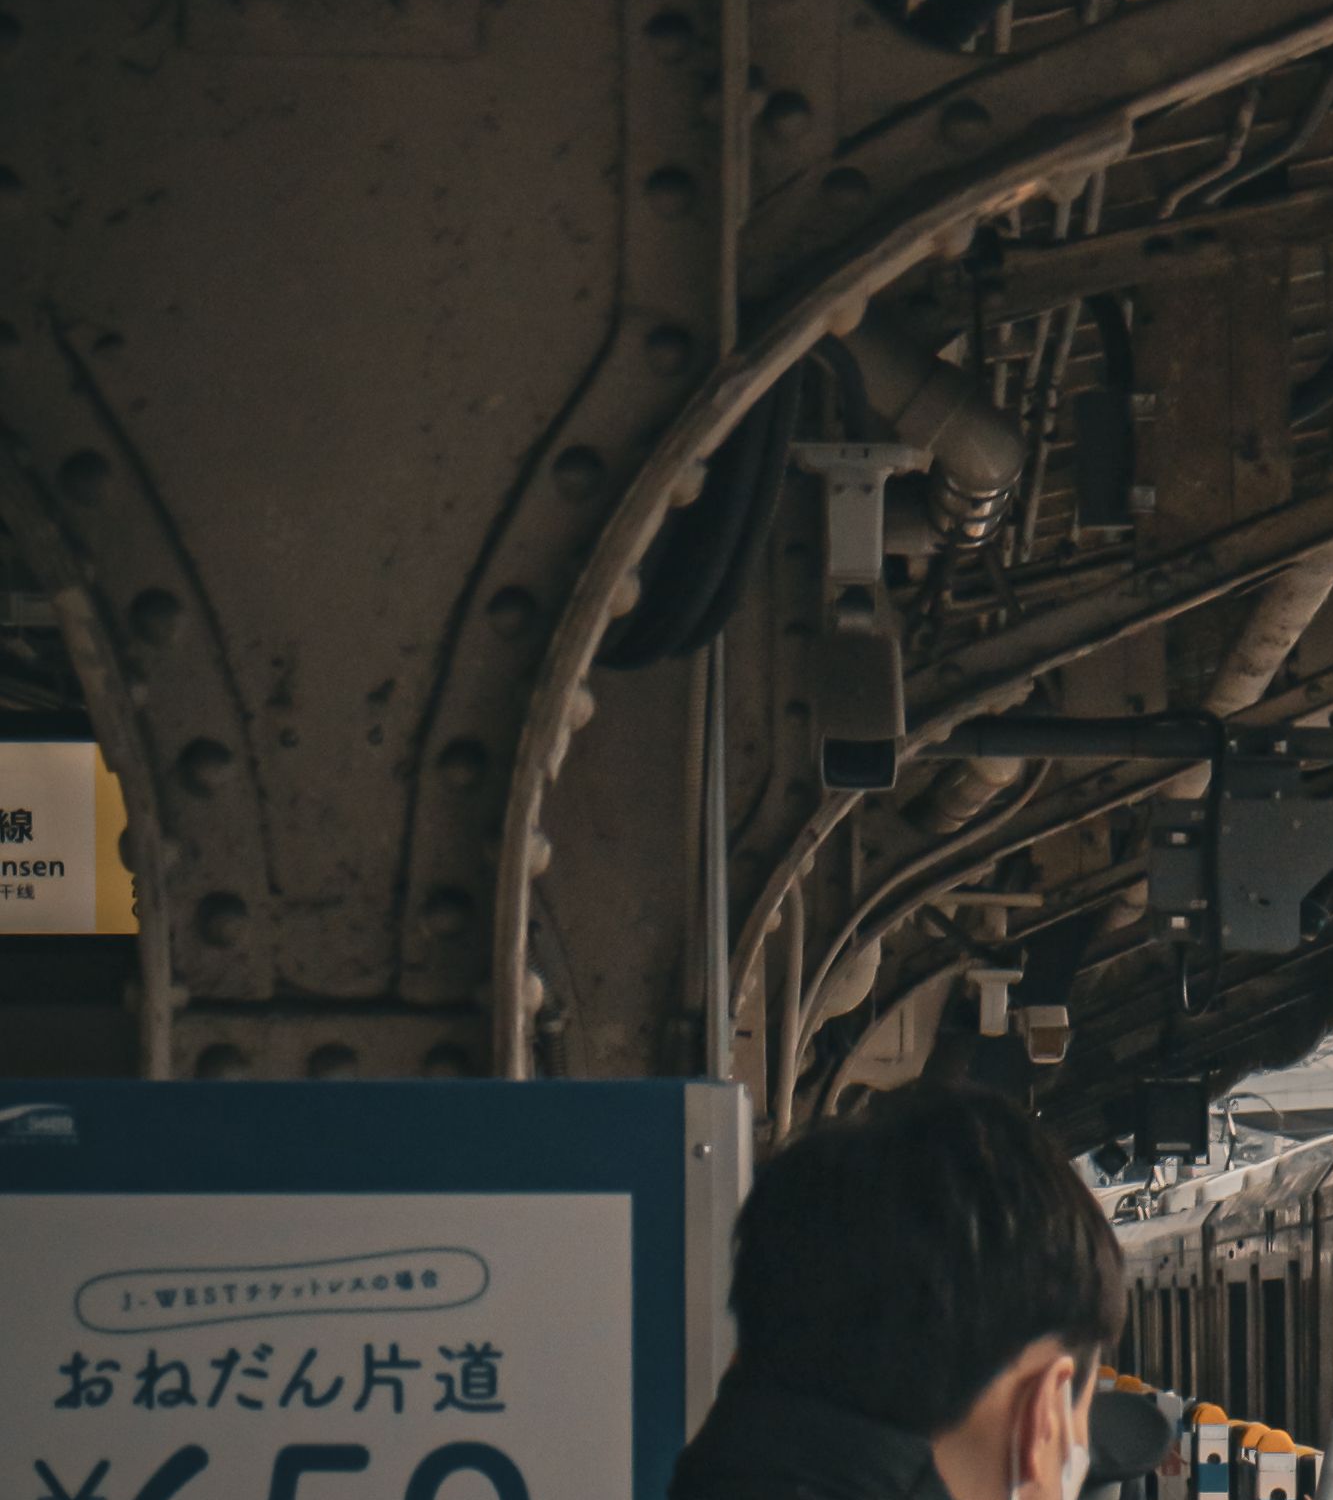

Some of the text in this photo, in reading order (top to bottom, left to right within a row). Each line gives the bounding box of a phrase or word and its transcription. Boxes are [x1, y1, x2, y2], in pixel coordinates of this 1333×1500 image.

[53, 1341, 506, 1413] おねだん片道
